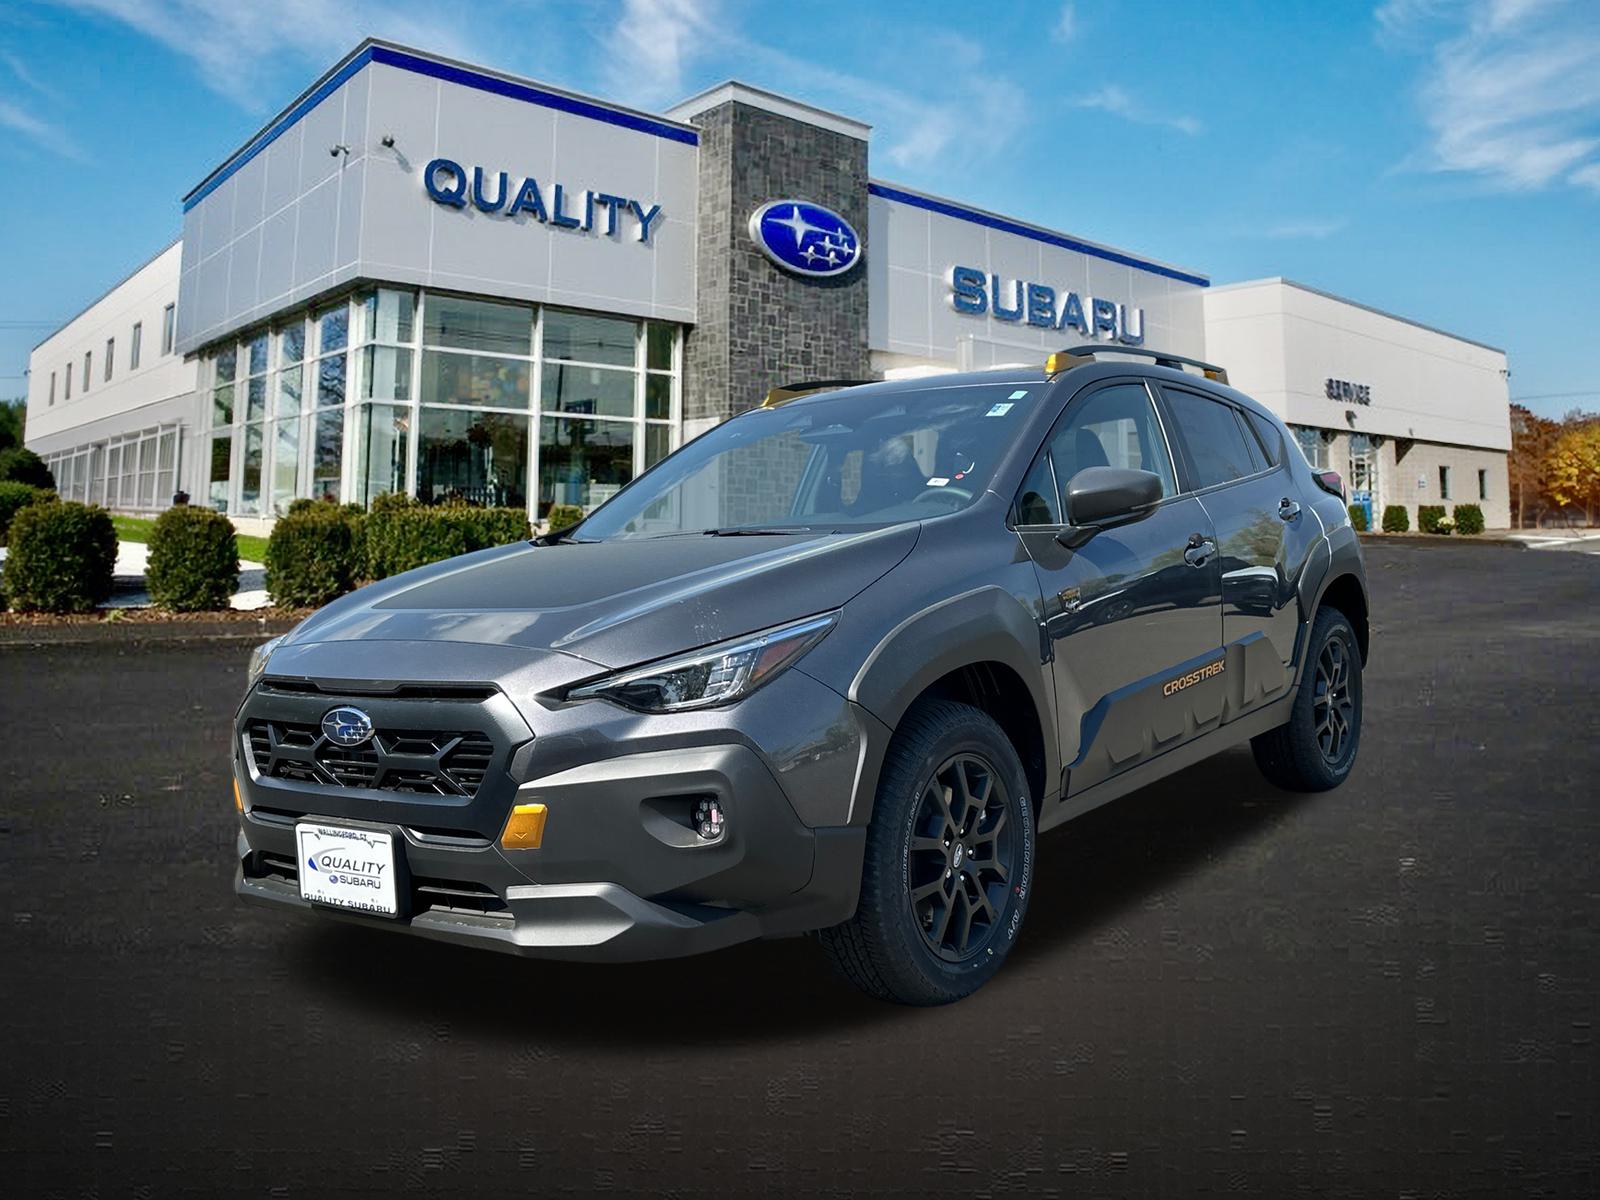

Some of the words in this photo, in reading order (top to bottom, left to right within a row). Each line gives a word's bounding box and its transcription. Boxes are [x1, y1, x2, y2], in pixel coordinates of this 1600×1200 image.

[423, 158, 662, 243] QUALITY
[951, 265, 1145, 346] SUBARU
[1325, 378, 1371, 406] SERVICE
[1162, 659, 1226, 697] CROSSTREK
[321, 855, 386, 875] QUALITY
[339, 875, 381, 889] SUBARU
[304, 893, 344, 906] QUALITY
[347, 900, 391, 914] SUBARU
